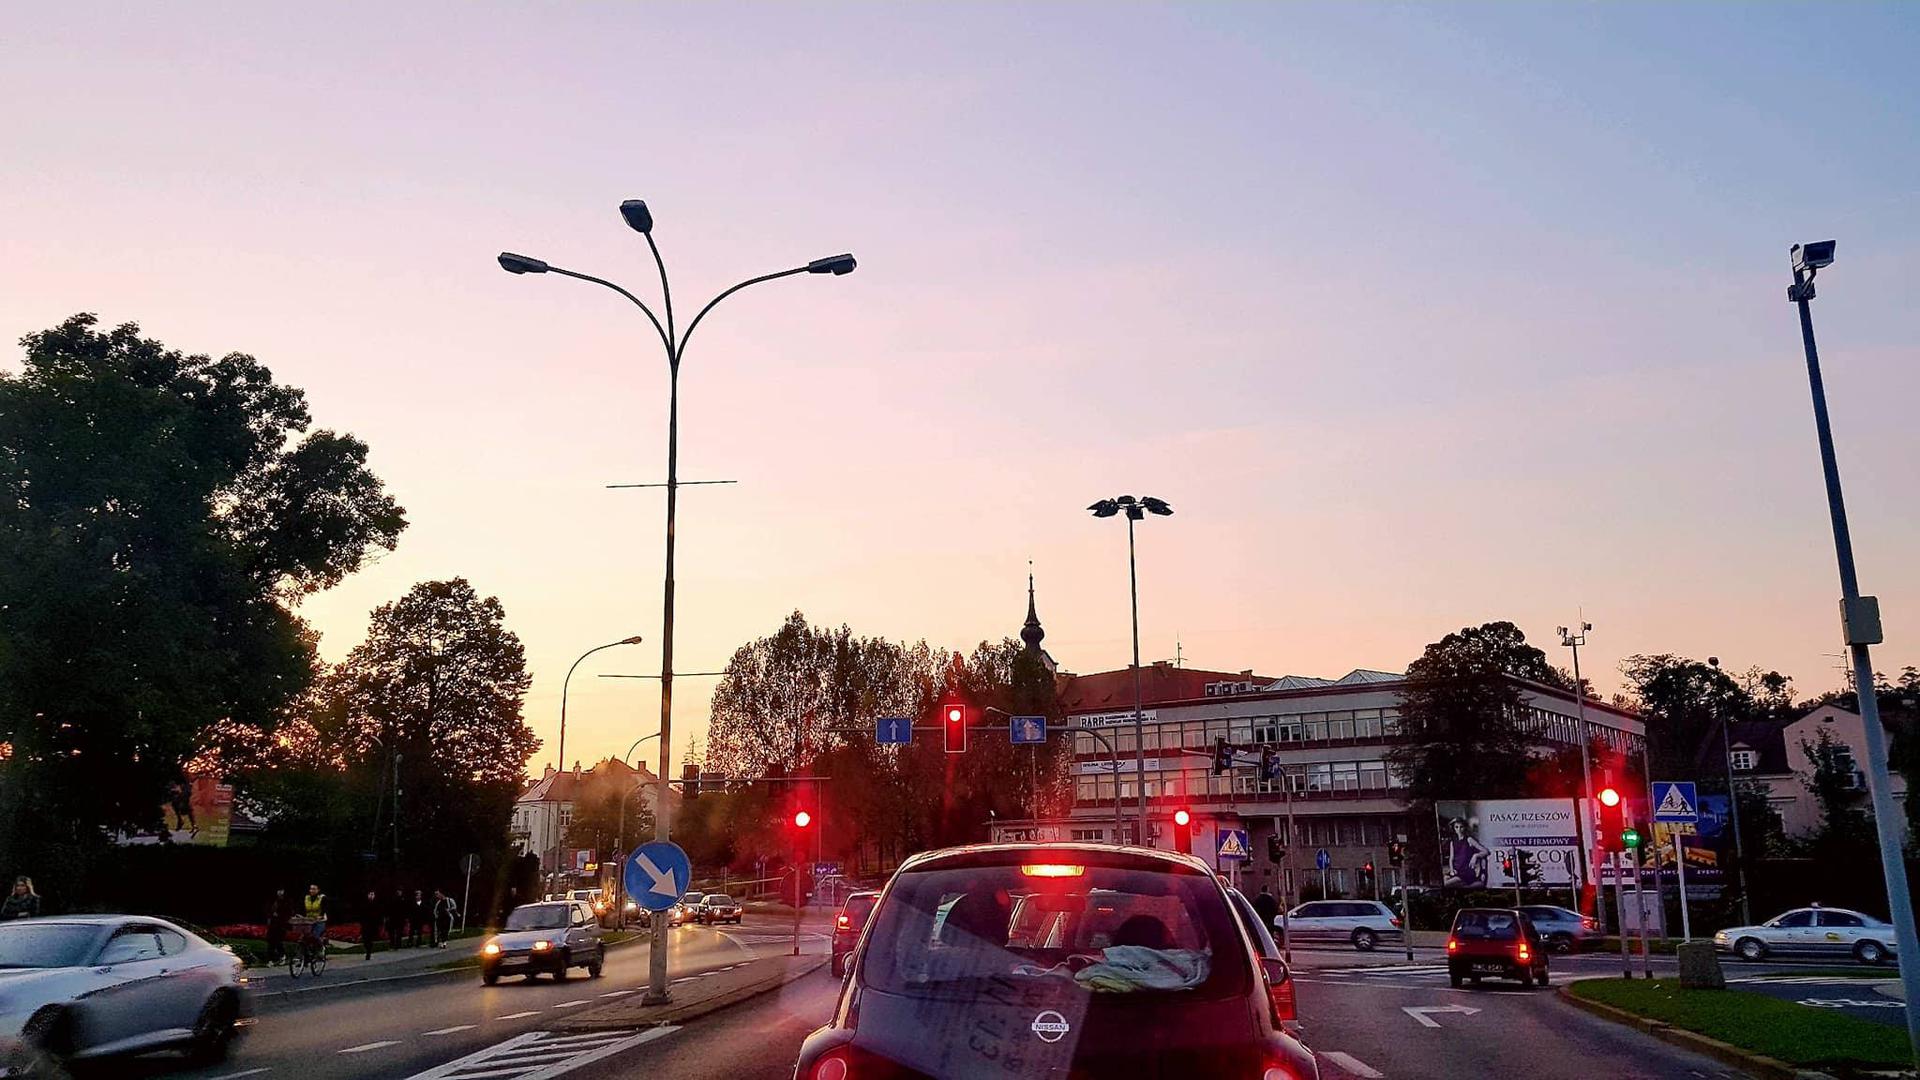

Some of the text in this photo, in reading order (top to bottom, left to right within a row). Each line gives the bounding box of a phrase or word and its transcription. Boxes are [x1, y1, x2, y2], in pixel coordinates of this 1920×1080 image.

[1081, 716, 1105, 728] RARR
[1521, 811, 1570, 821] RZESZÓW
[1499, 837, 1570, 846] SALON FIRMOWY
[1035, 1023, 1066, 1031] NISSAN
